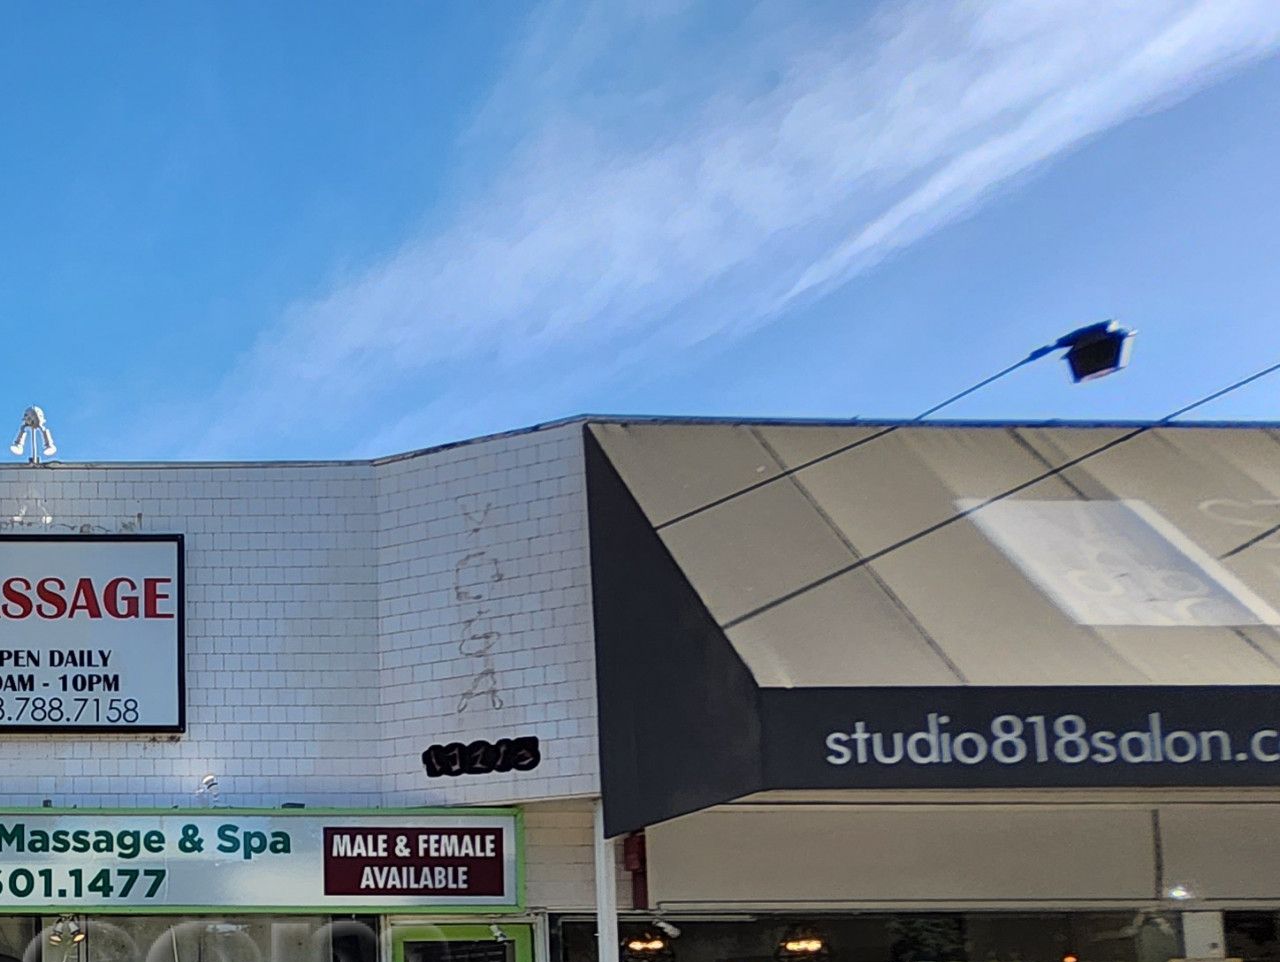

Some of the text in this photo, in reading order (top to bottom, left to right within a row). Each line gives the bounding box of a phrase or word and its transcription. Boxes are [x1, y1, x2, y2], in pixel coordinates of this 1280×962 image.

[49, 649, 112, 667] DAILY
[57, 674, 120, 692] 10PM
[178, 823, 204, 854] &
[216, 824, 291, 860] Spa
[332, 835, 496, 857] MALE & FEMALE
[360, 867, 468, 889] AVAILABLE
